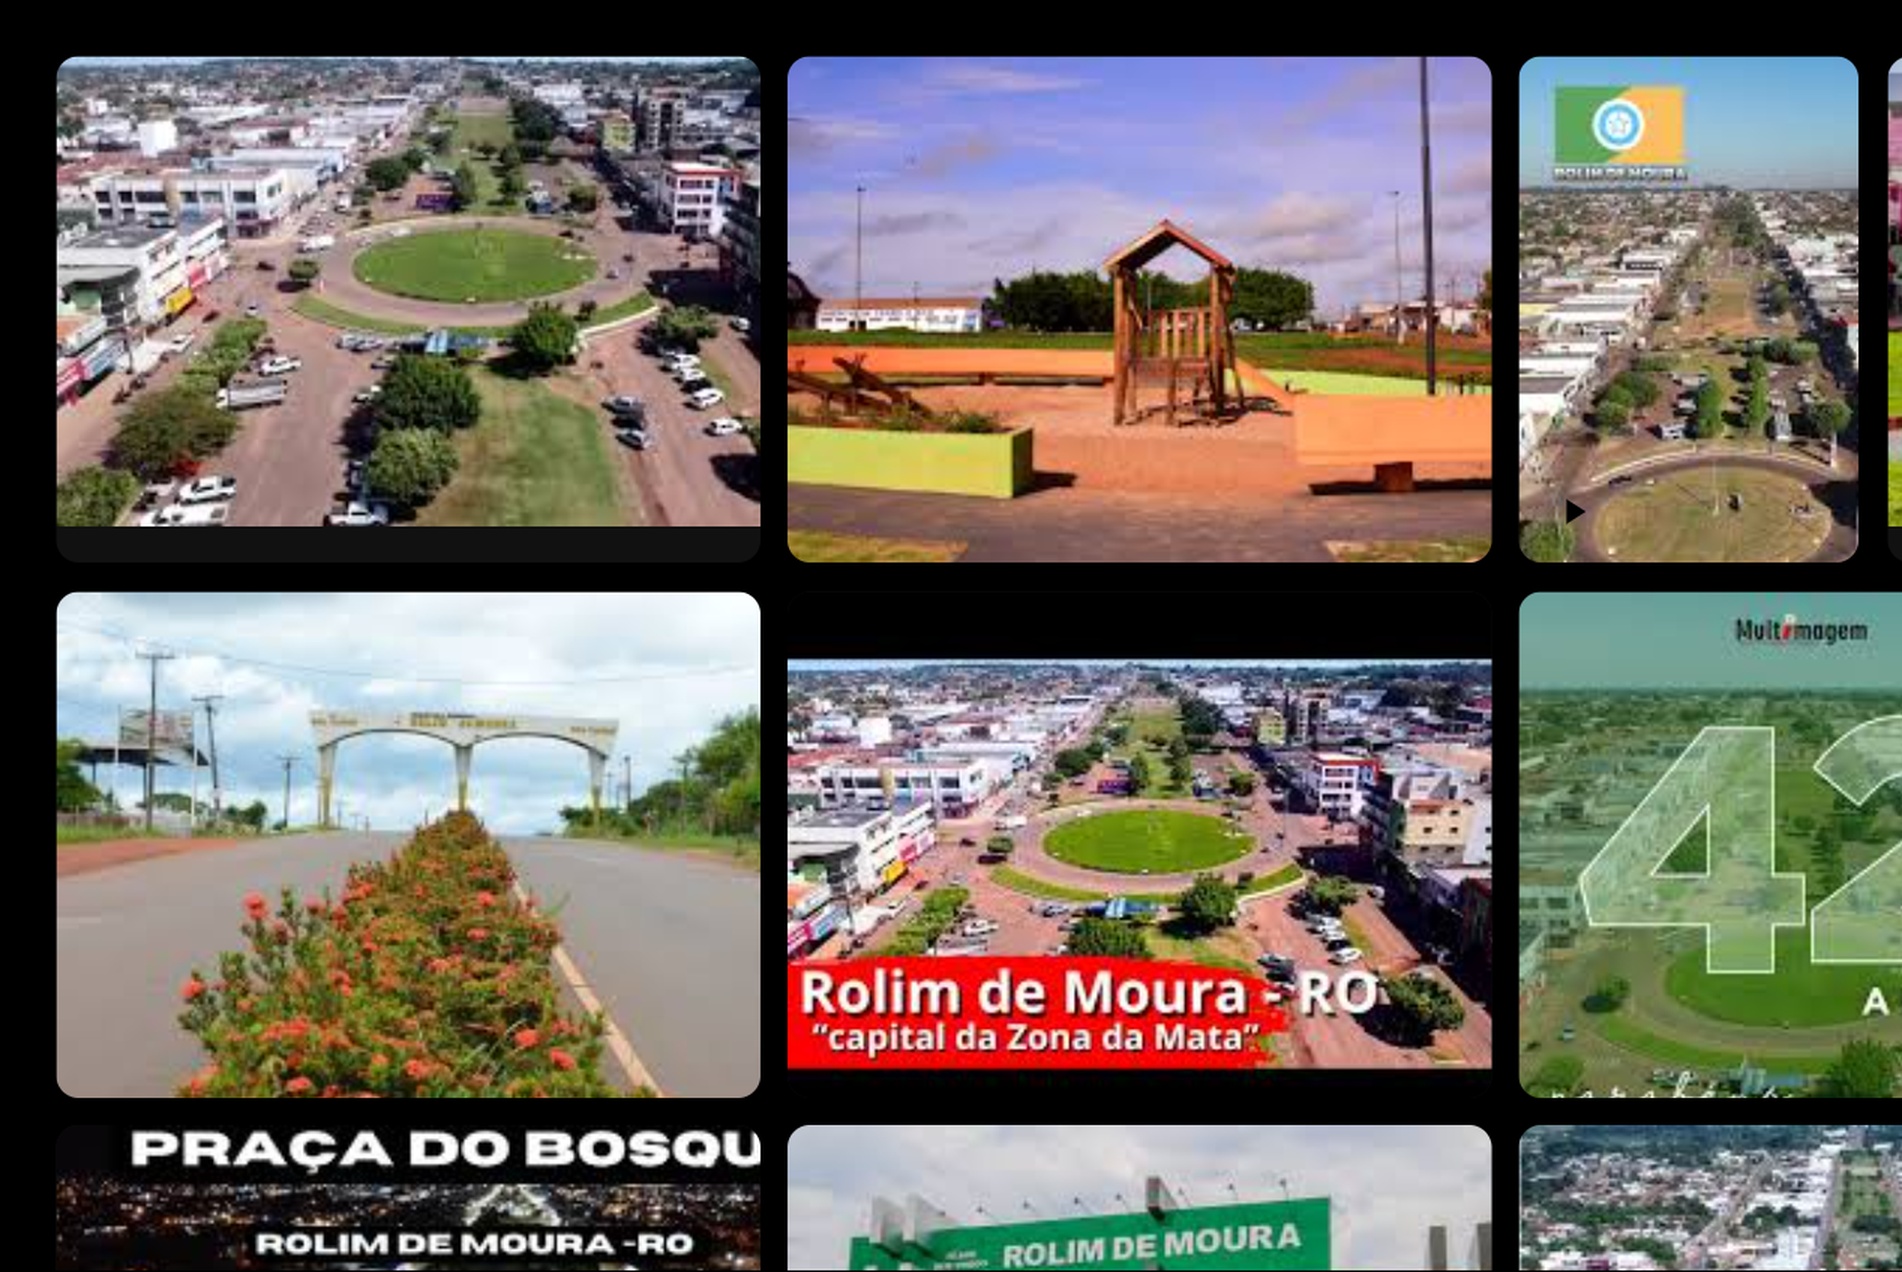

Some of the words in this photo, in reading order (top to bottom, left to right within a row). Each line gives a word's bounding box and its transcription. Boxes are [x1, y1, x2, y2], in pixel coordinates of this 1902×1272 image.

[1003, 1237, 1104, 1269] ROLIM
[1112, 1234, 1157, 1260] DE
[1164, 1223, 1301, 1258] MOURA
